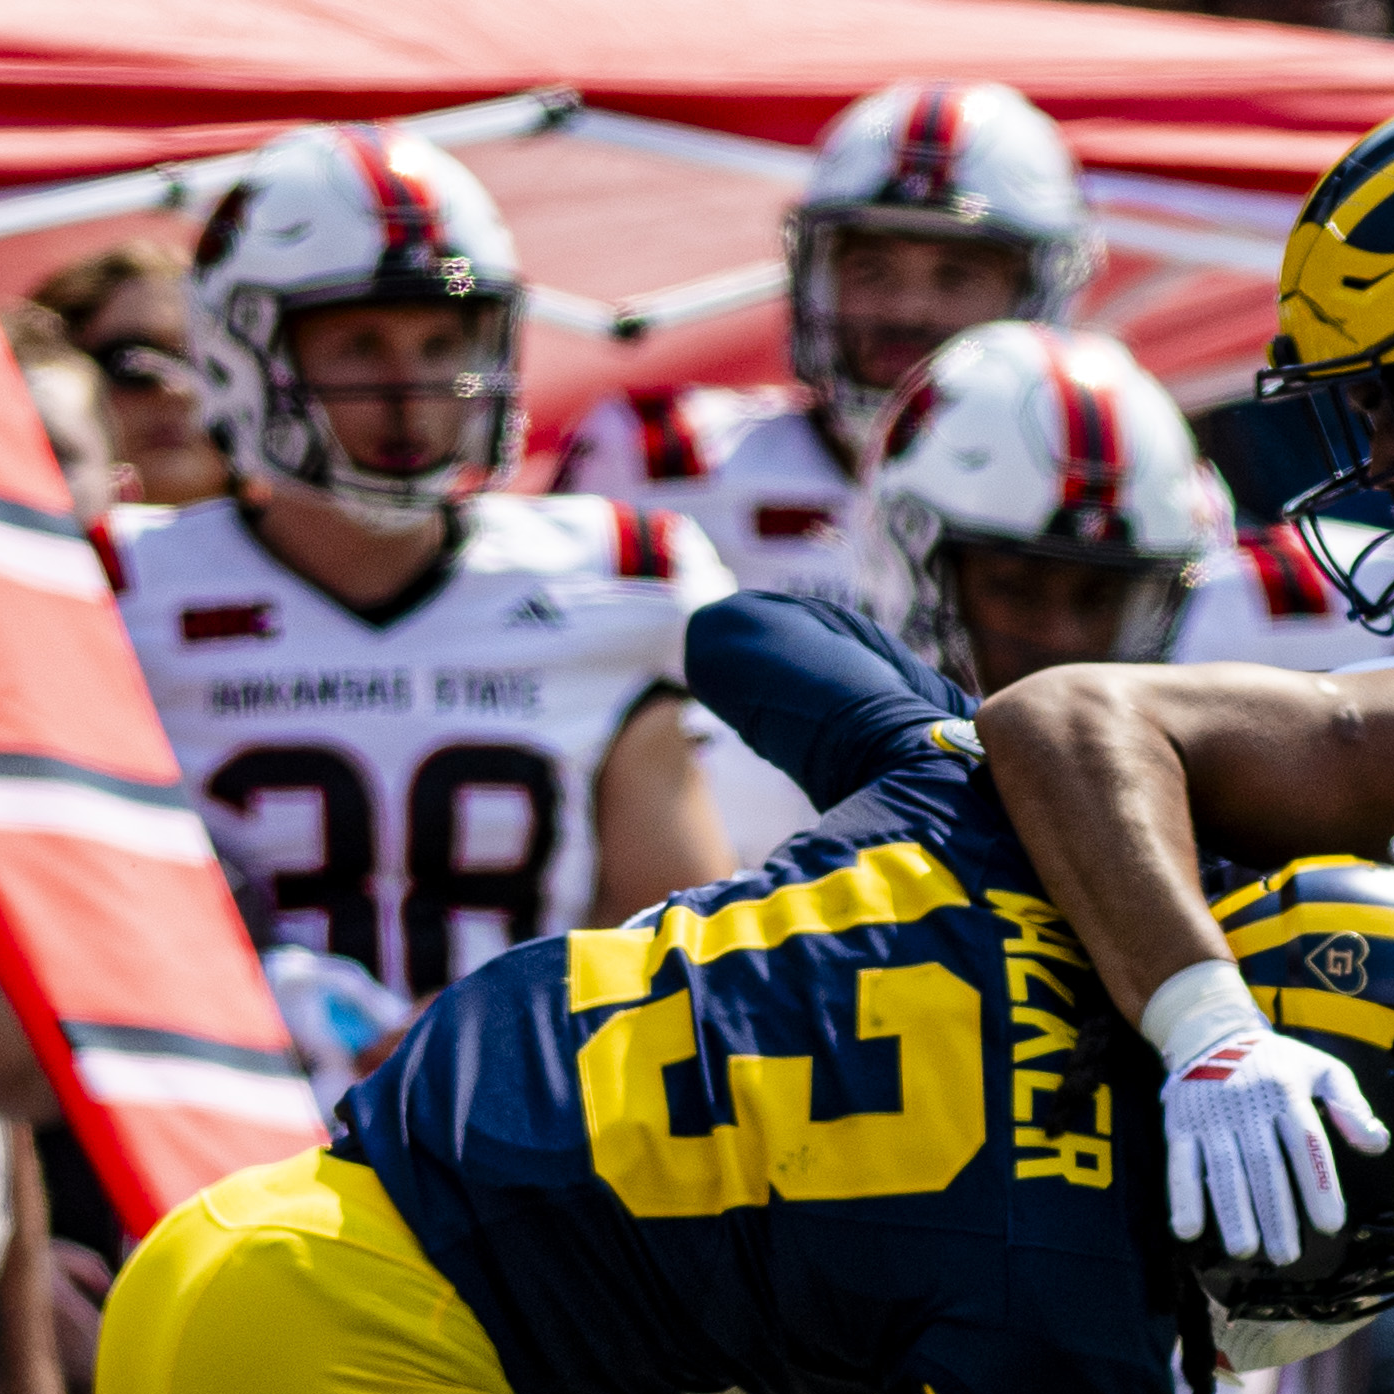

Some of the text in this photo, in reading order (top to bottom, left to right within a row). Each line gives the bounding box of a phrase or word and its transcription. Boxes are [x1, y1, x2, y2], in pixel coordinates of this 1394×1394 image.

[211, 666, 545, 718] ARKANSAS STATE
[205, 740, 563, 1000] 38
[565, 841, 987, 1218] 13
